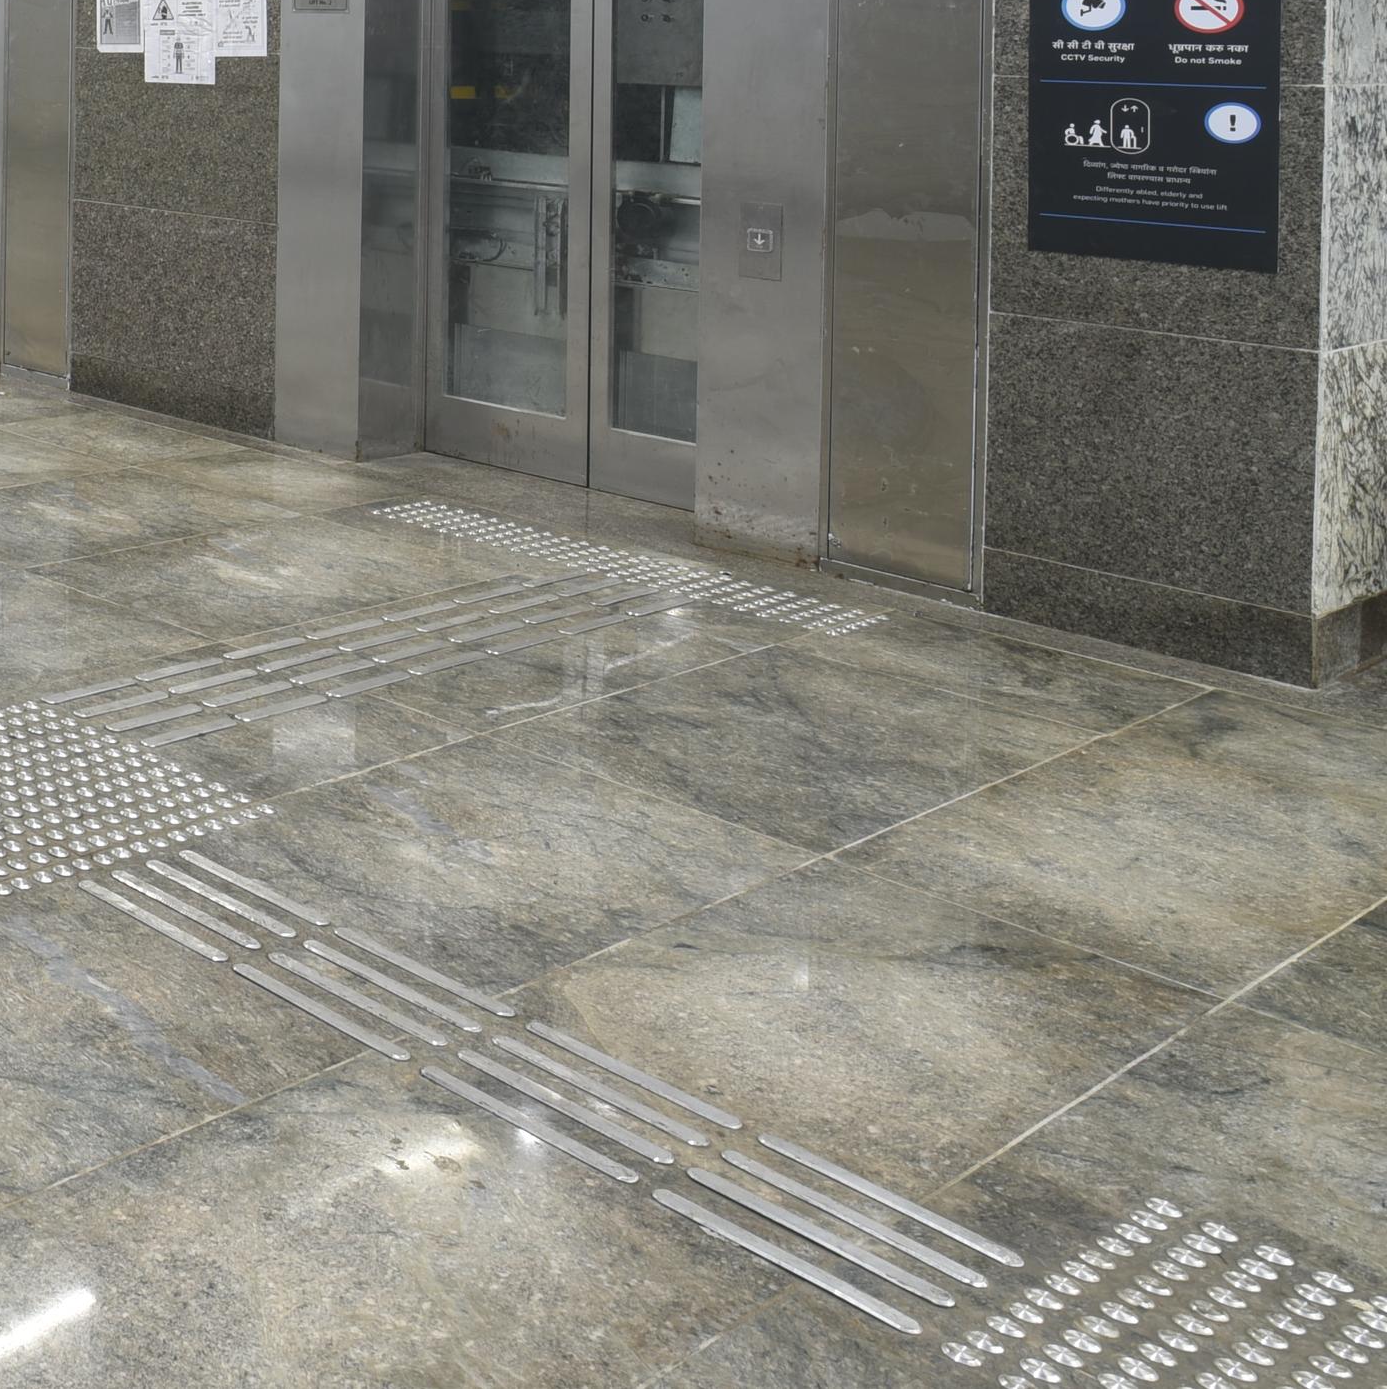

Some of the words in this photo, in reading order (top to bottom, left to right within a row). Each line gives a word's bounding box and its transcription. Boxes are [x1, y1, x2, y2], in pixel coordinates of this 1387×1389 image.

[1052, 39, 1064, 49] सी
[1066, 39, 1079, 49] सी
[1081, 39, 1092, 50] टी
[1107, 42, 1135, 53] सुरक्षा
[1226, 44, 1249, 53] नका
[1087, 54, 1126, 64] Security
[1174, 56, 1188, 64] Do
[1208, 57, 1242, 65] Smoke
[1095, 186, 1134, 195] Differently
[1135, 189, 1159, 197] abled,
[1160, 191, 1186, 199] elderly
[1073, 194, 1108, 203] expecting
[1109, 196, 1140, 205] mothers
[1142, 198, 1160, 206] have
[1161, 200, 1189, 209] priority
